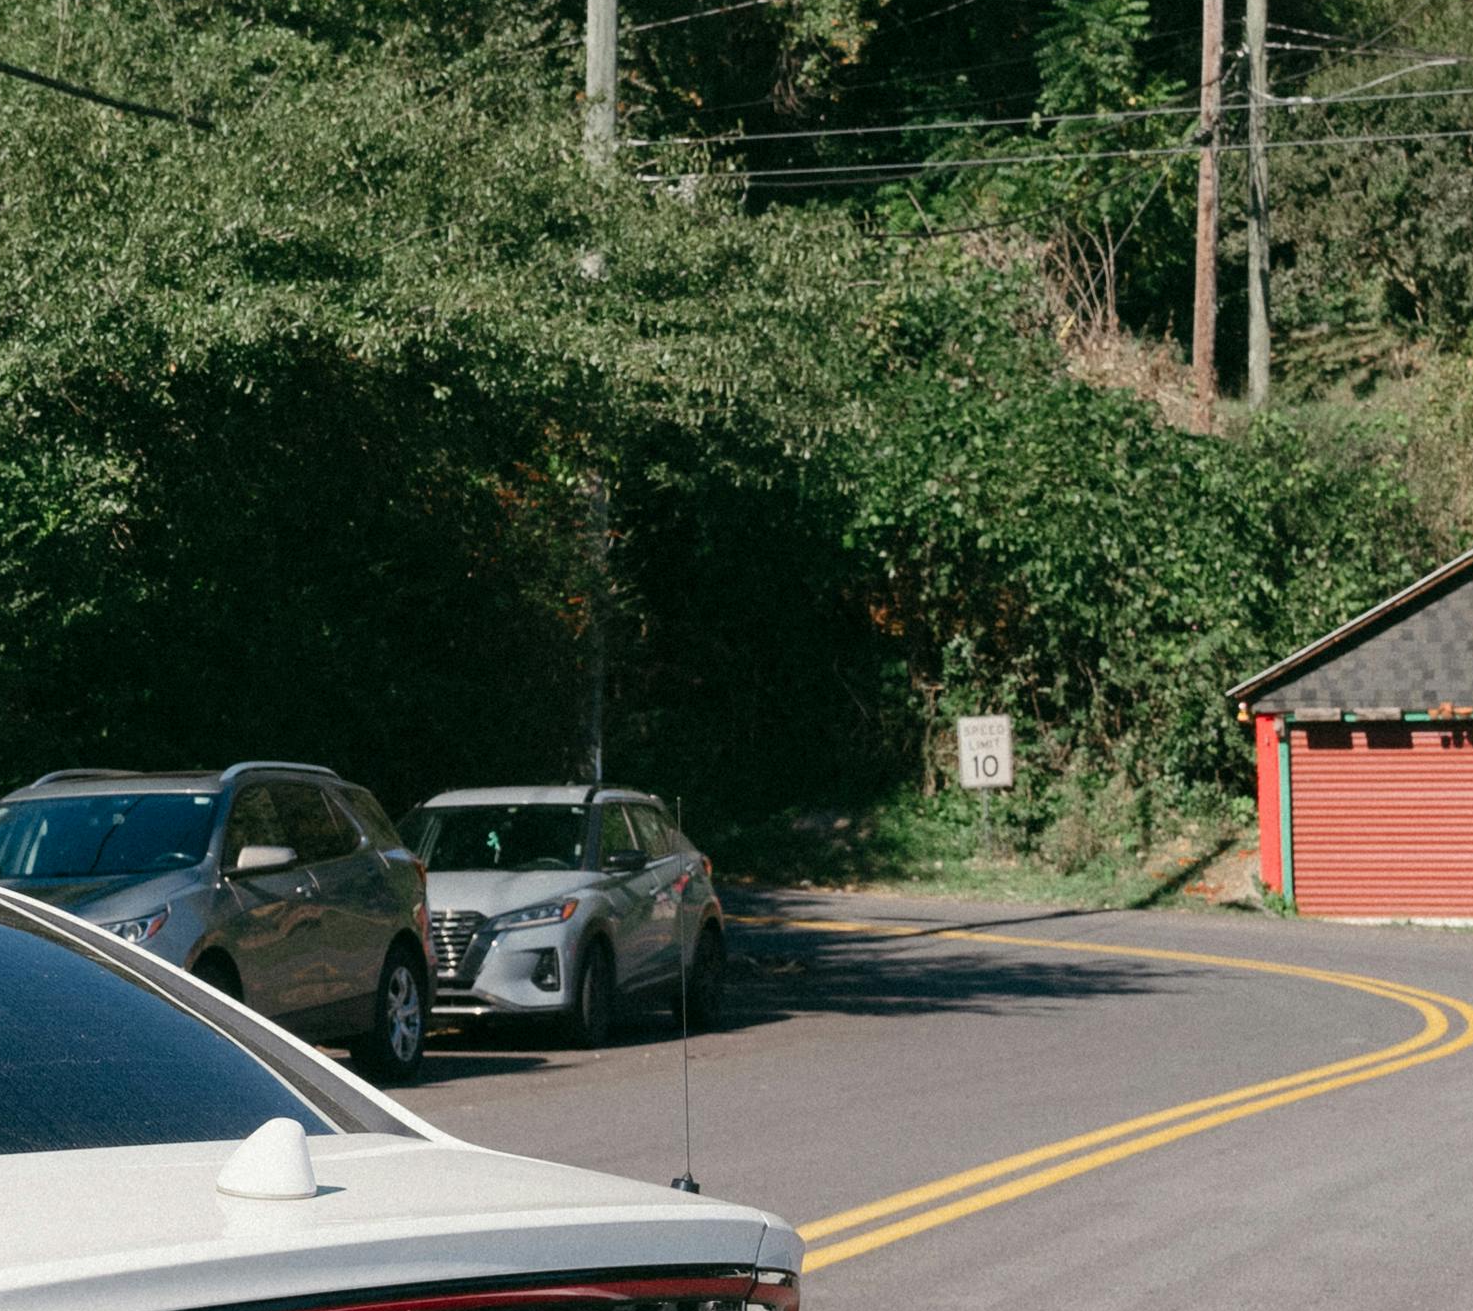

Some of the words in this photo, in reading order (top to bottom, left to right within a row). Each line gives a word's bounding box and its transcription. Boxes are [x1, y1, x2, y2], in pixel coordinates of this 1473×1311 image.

[963, 723, 1005, 737] SPEED
[968, 737, 999, 751] LIMIT
[974, 755, 999, 778] 10
